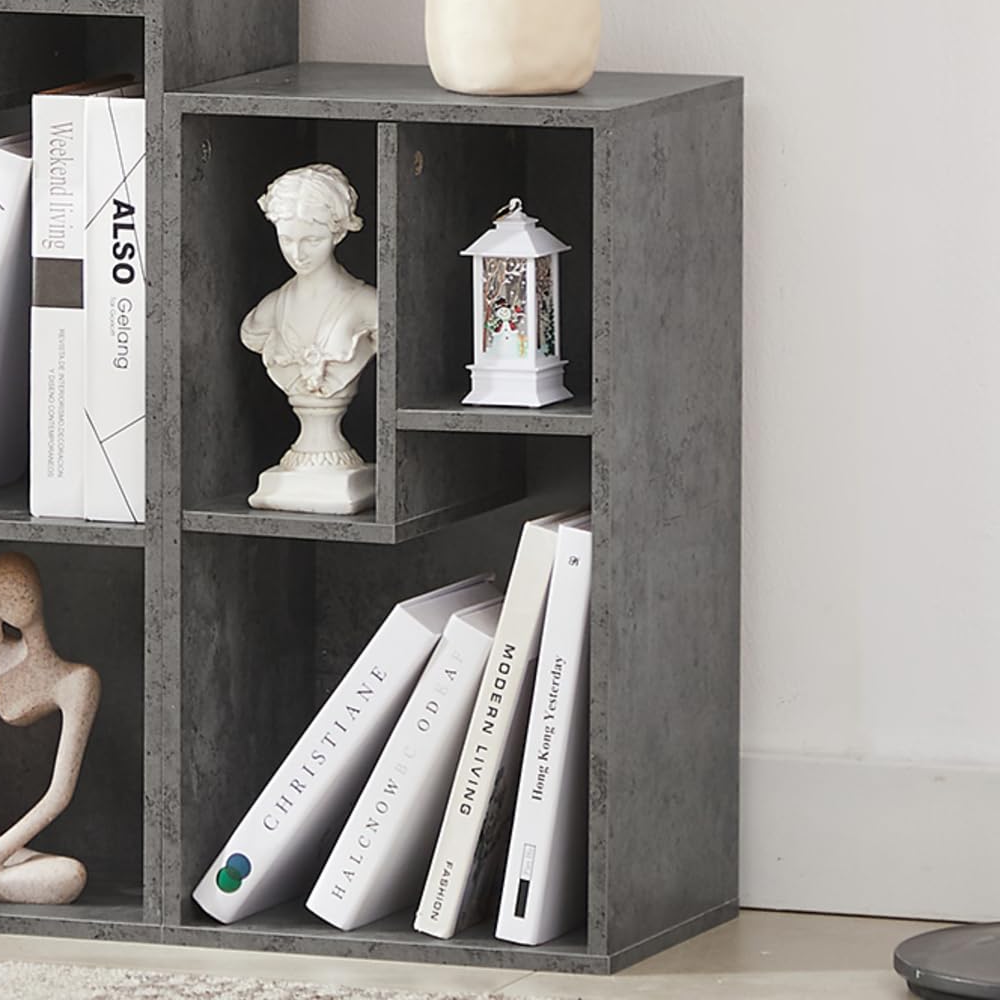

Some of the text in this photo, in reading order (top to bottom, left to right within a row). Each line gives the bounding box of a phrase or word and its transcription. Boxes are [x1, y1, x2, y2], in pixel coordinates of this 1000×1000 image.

[42, 122, 74, 250] Weekend living
[112, 198, 136, 285] ALSO
[113, 298, 133, 370] Gelang
[263, 666, 388, 832] CHRISTIANE
[459, 643, 517, 816] MODERN LIVING
[531, 655, 567, 802] Hong Kong Yesterday
[430, 861, 454, 922] FASHION
